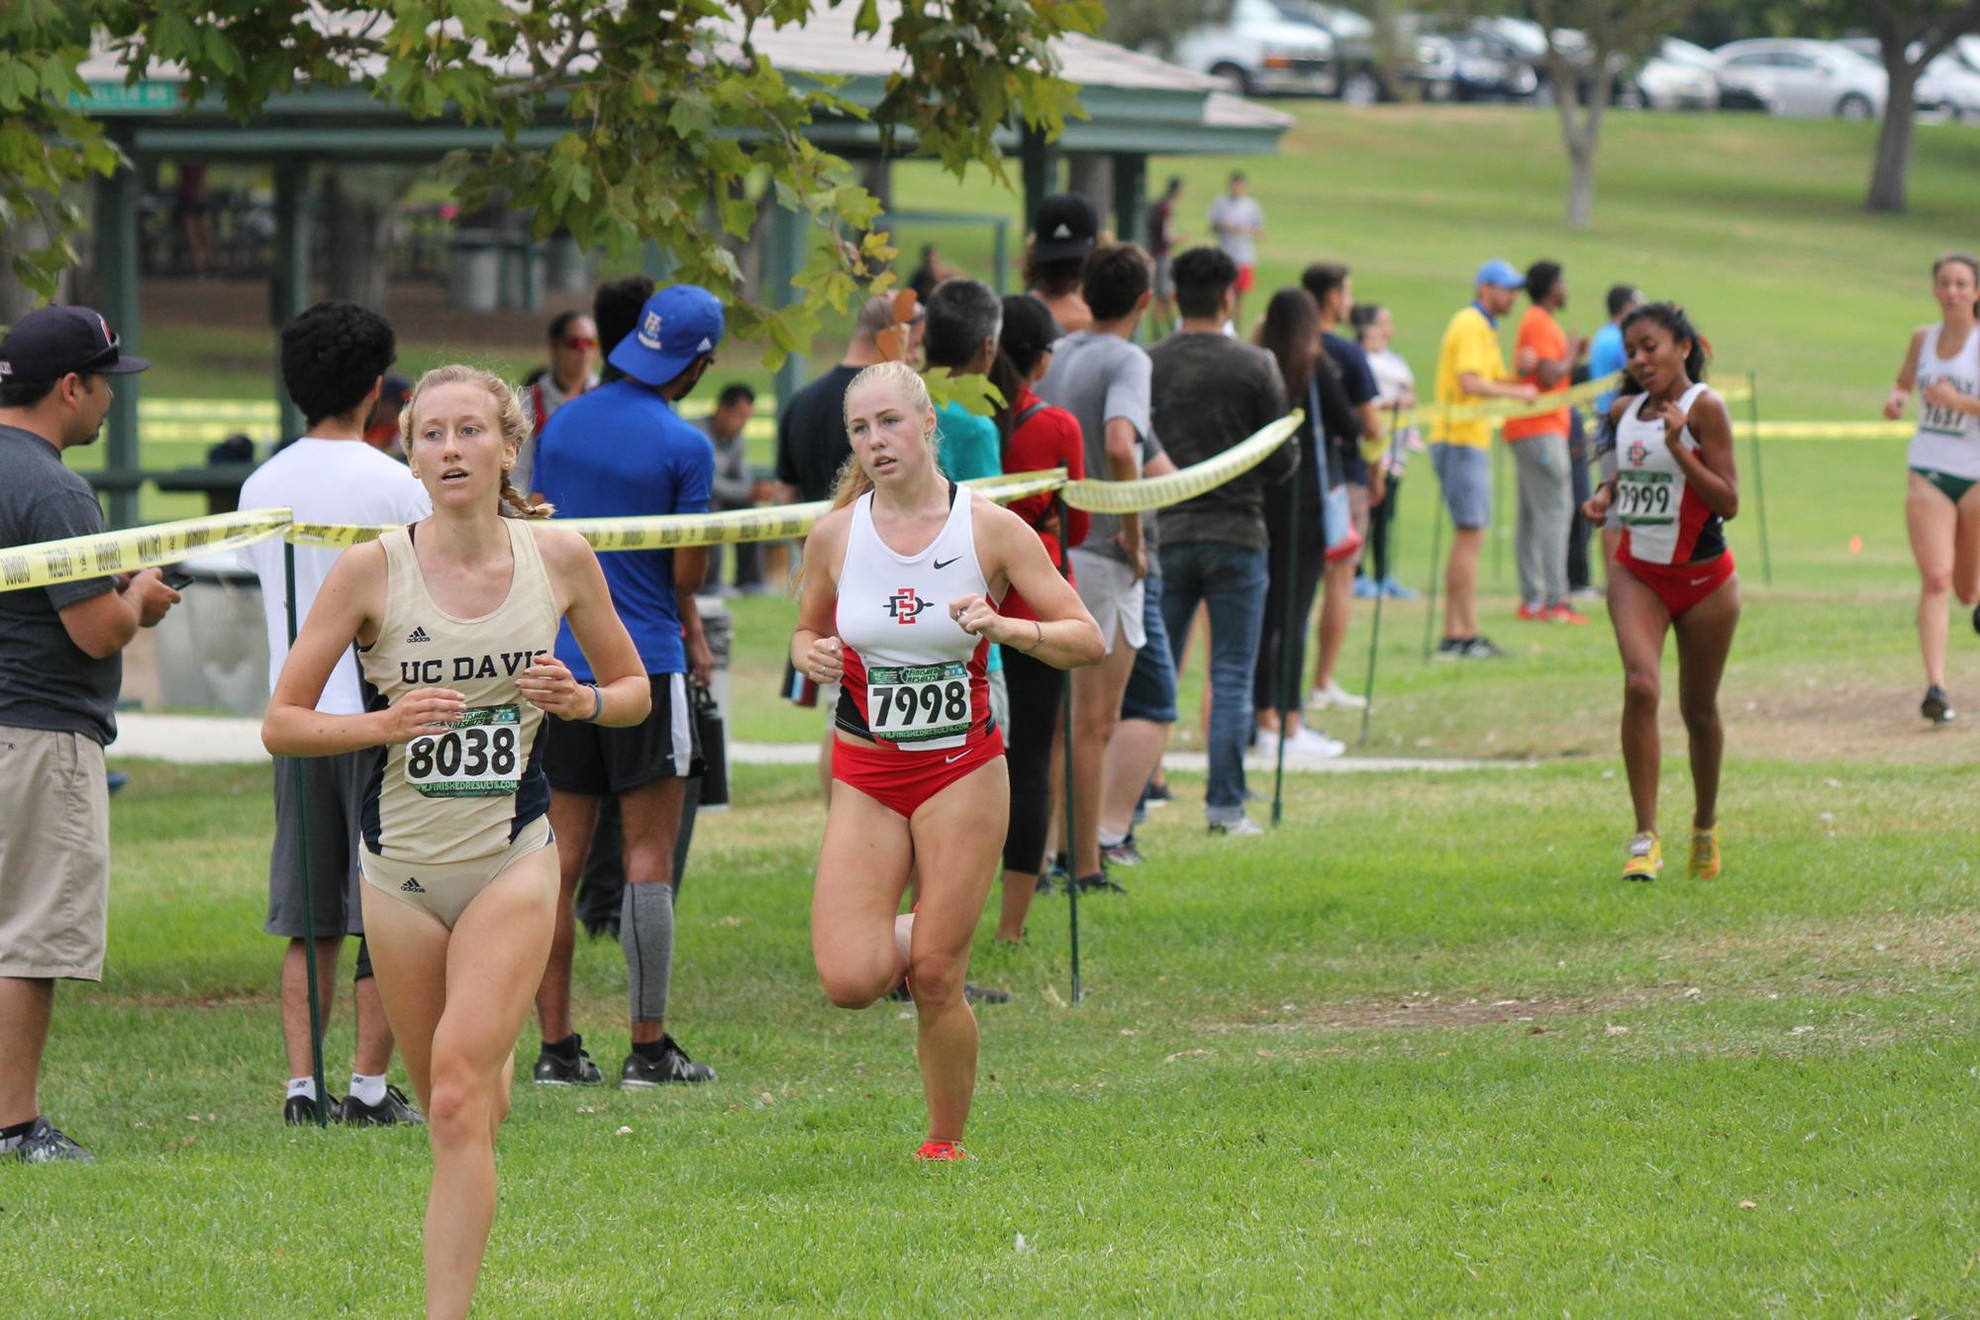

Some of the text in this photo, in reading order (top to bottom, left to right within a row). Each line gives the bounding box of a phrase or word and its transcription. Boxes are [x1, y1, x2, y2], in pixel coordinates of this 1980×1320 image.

[1620, 486, 1669, 513] 7999
[406, 635, 431, 644] adidas
[401, 660, 442, 684] UC
[872, 680, 967, 727] 7998
[408, 727, 516, 778] 8038
